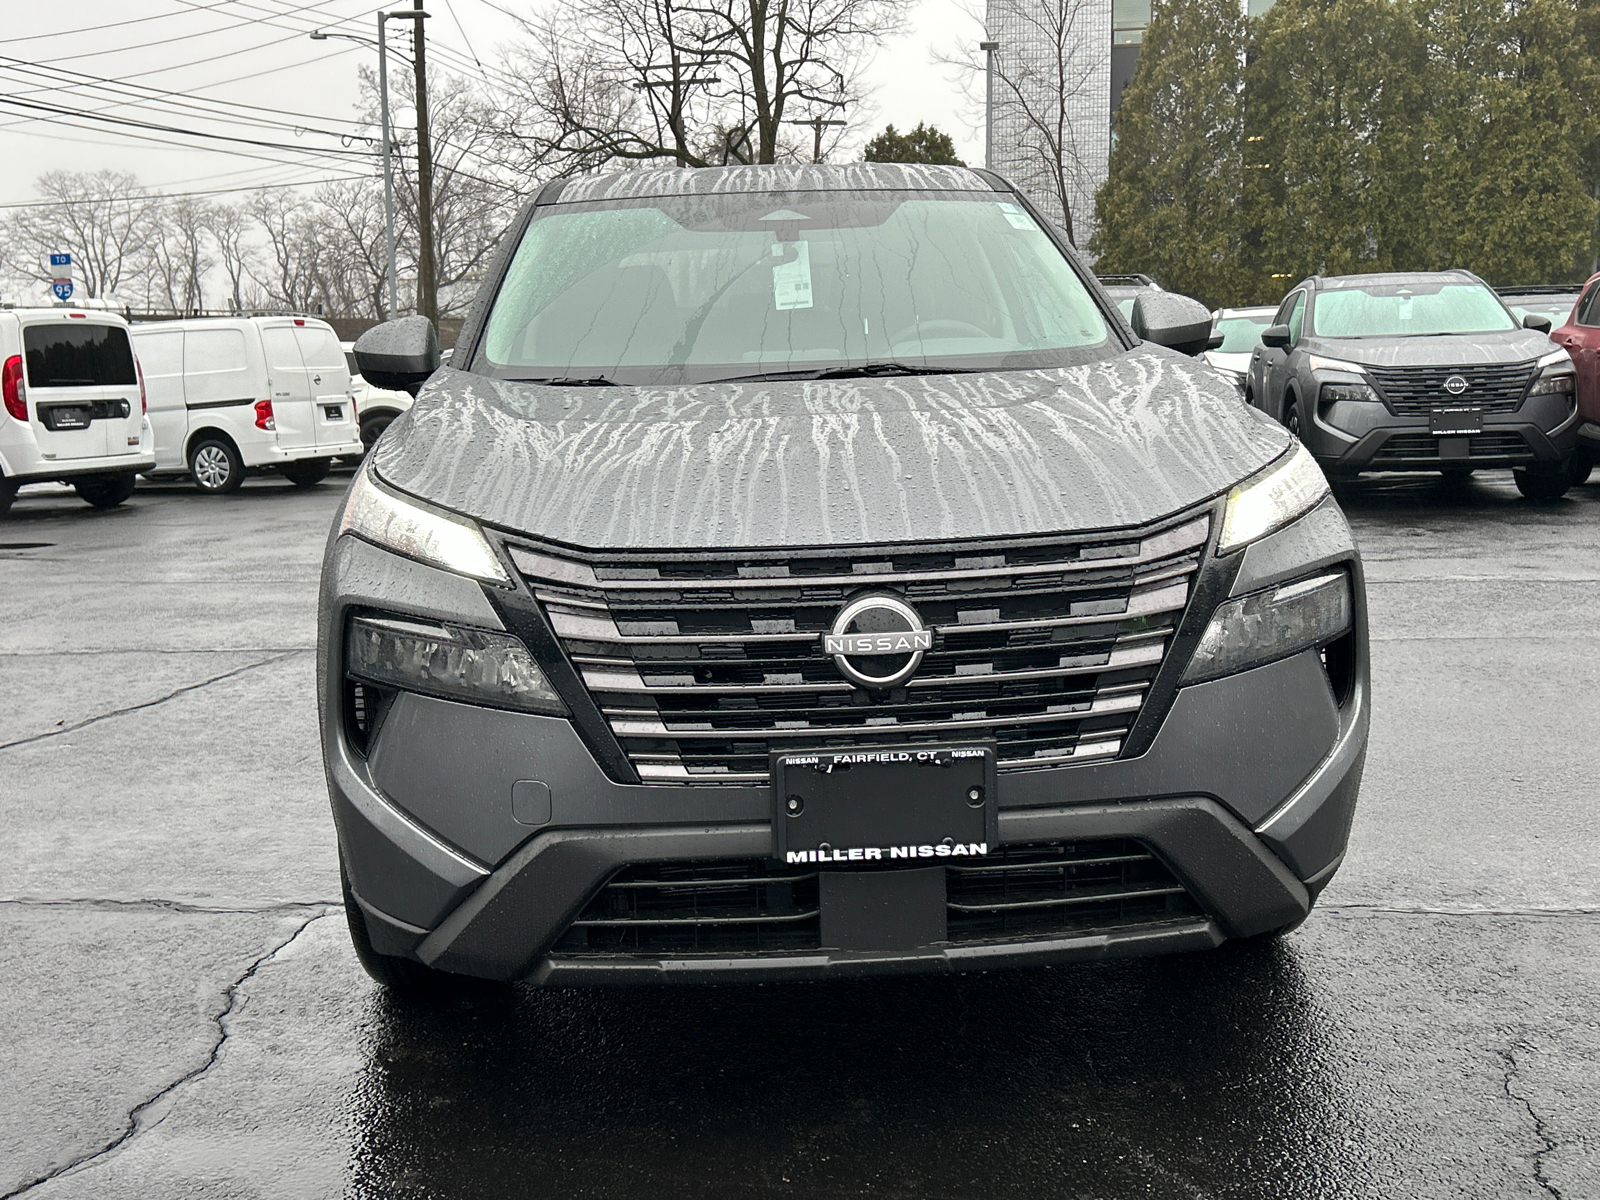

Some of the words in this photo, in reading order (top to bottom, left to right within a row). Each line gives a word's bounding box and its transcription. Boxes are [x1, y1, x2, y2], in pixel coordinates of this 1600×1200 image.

[55, 256, 66, 264] TO
[56, 285, 71, 297] 95
[827, 634, 930, 652] NISSAN
[833, 752, 913, 764] FAIRFIELD,
[916, 752, 937, 760] CT
[786, 847, 882, 864] MILLER
[890, 842, 988, 859] NISSAN
